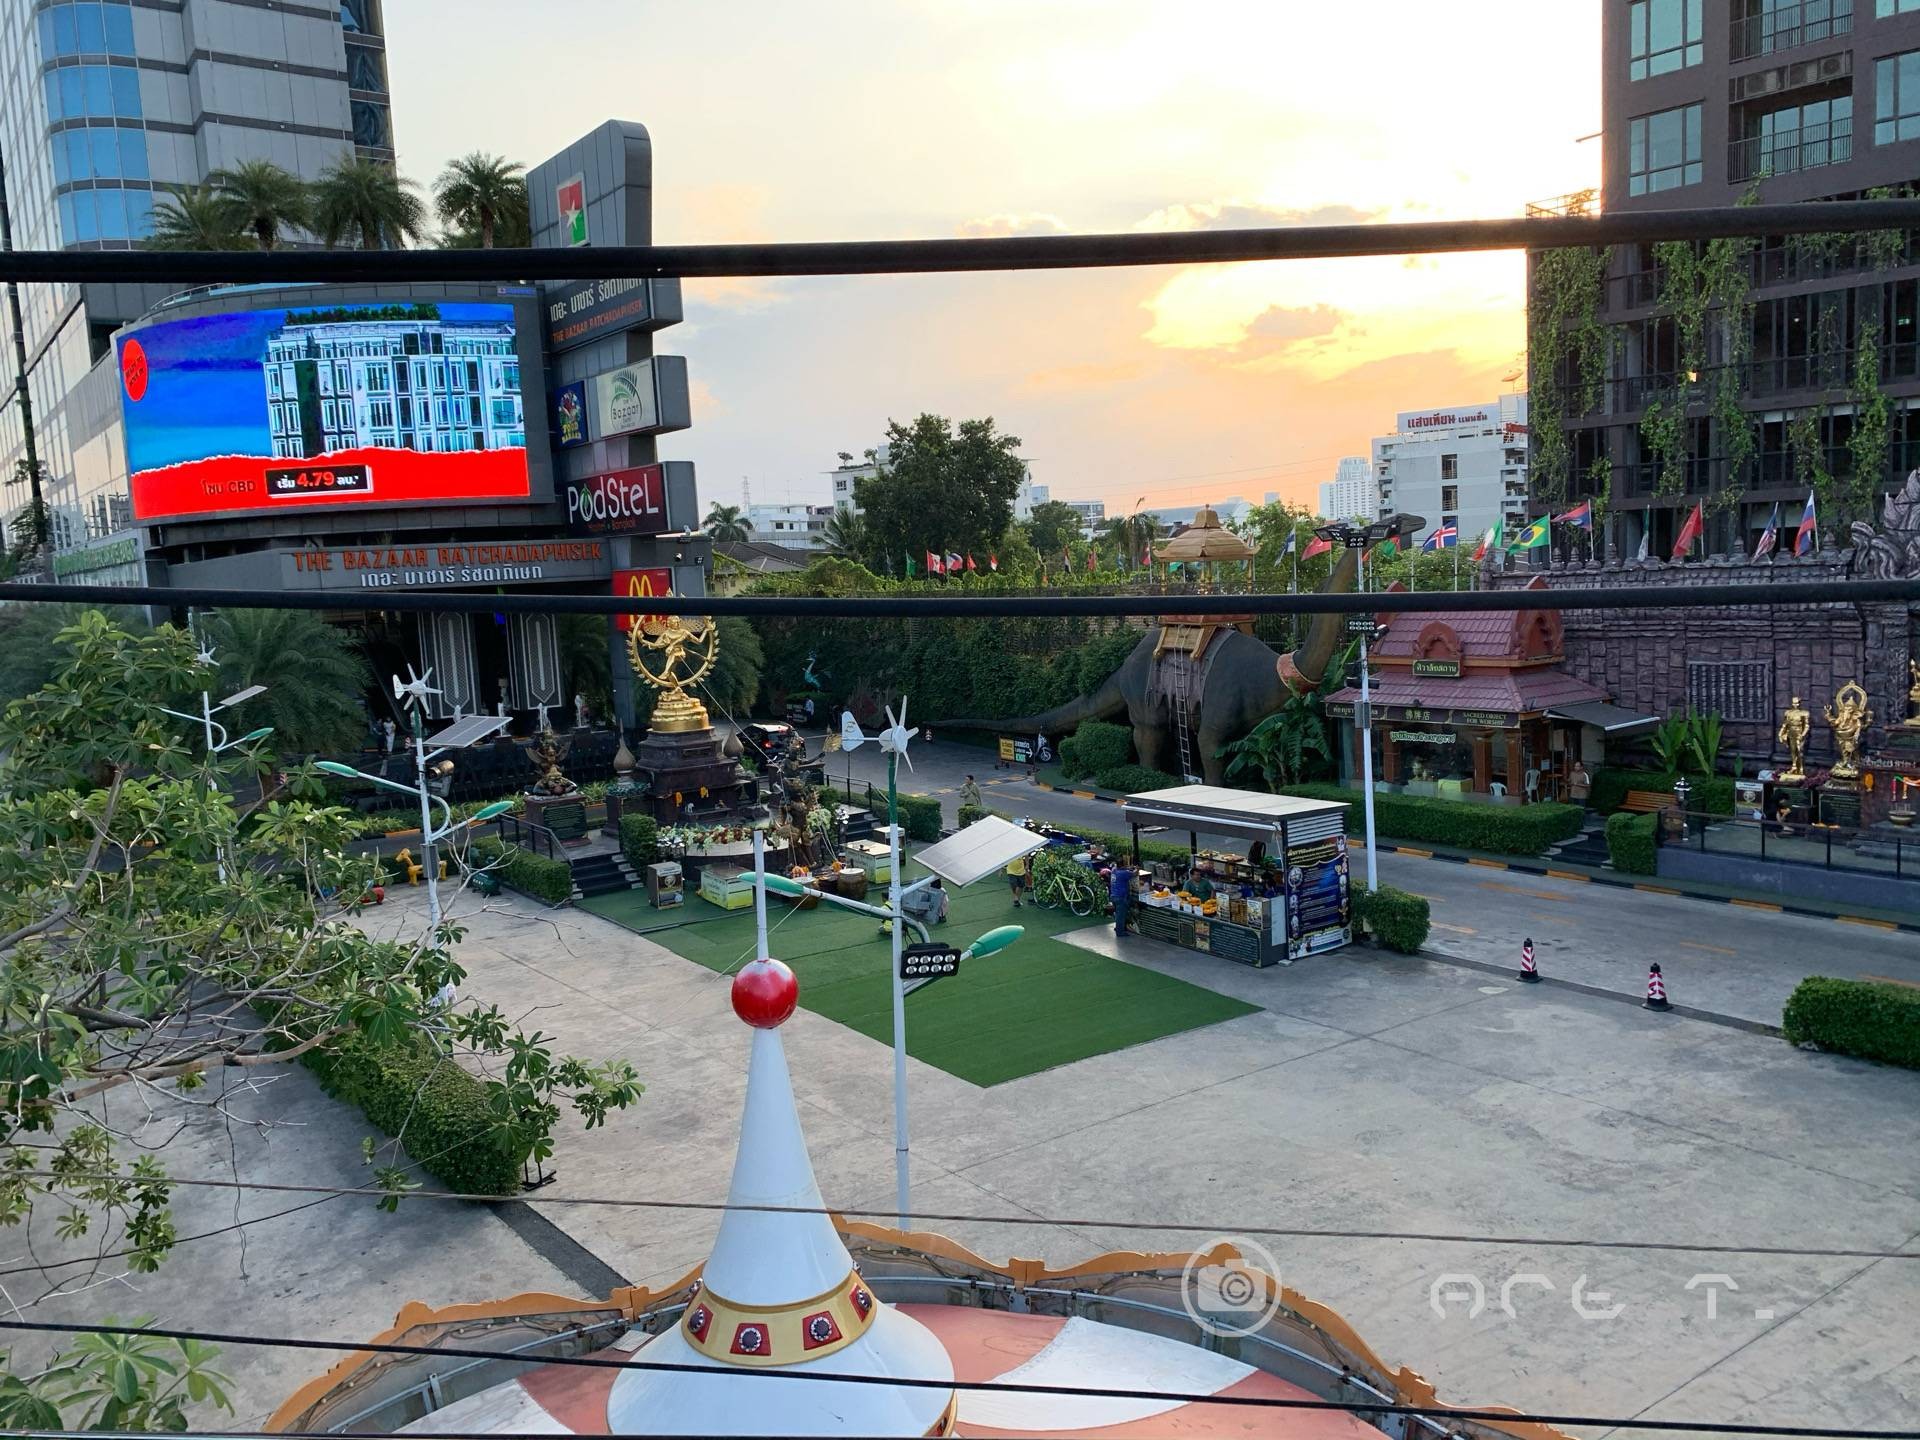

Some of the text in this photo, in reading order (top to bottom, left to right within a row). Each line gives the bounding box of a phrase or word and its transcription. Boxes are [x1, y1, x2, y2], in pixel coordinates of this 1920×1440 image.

[228, 480, 256, 492] CBD
[297, 471, 334, 487] 4.79
[293, 542, 602, 571] THE BAZAAR RATCHADAPHISEK
[360, 572, 398, 588] เดอะ
